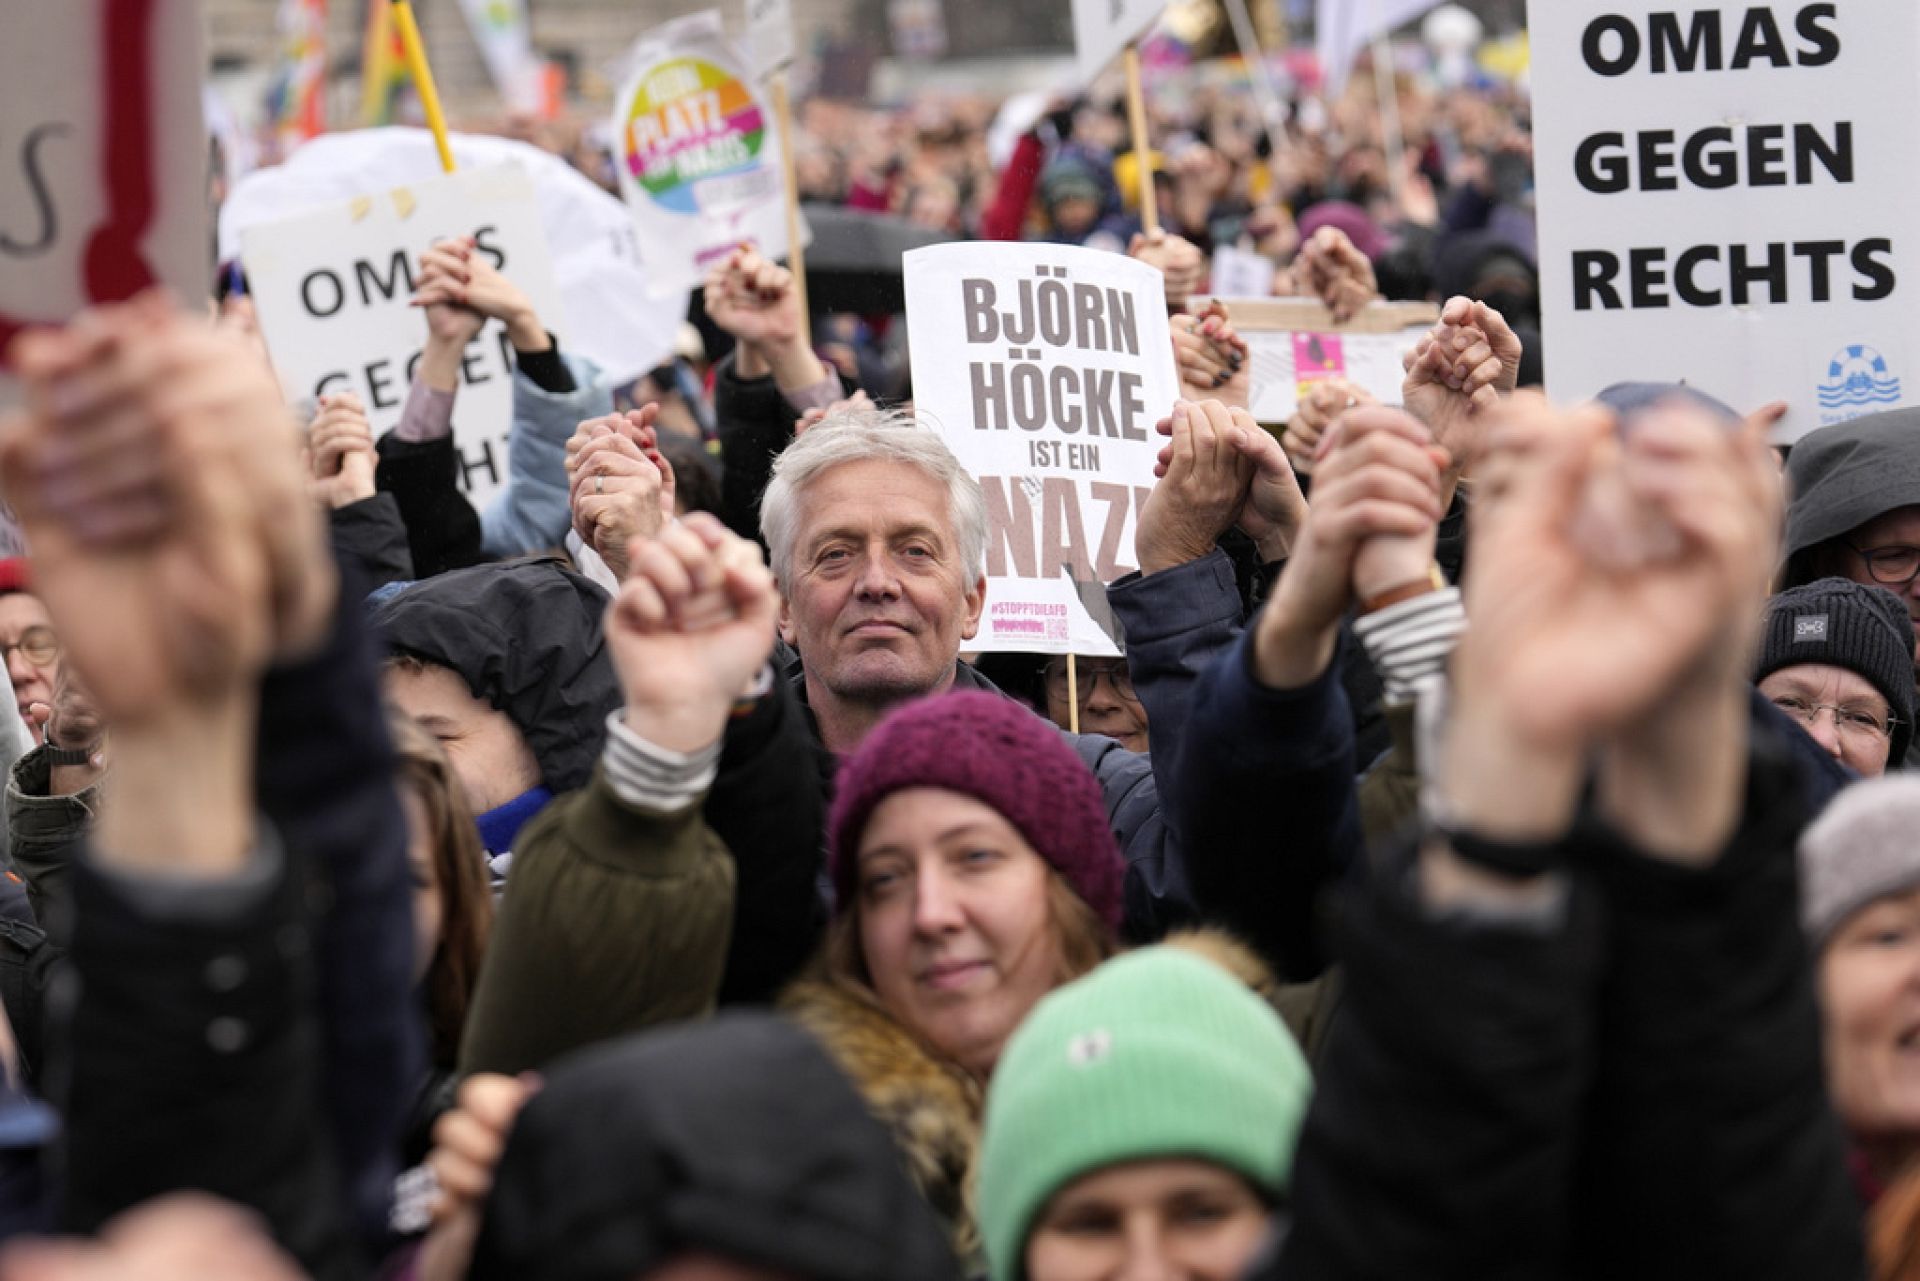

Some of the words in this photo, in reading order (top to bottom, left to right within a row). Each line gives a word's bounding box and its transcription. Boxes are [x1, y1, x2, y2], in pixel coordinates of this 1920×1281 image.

[1581, 3, 1840, 77] OMAS
[1573, 121, 1854, 193] GEGEN
[301, 225, 506, 318] OMS
[1571, 238, 1896, 311] RECHTS
[962, 265, 1140, 356] BJÖRN
[969, 348, 1147, 442] HÖCKE
[1029, 440, 1061, 467] IST
[1067, 443, 1101, 471] EIN
